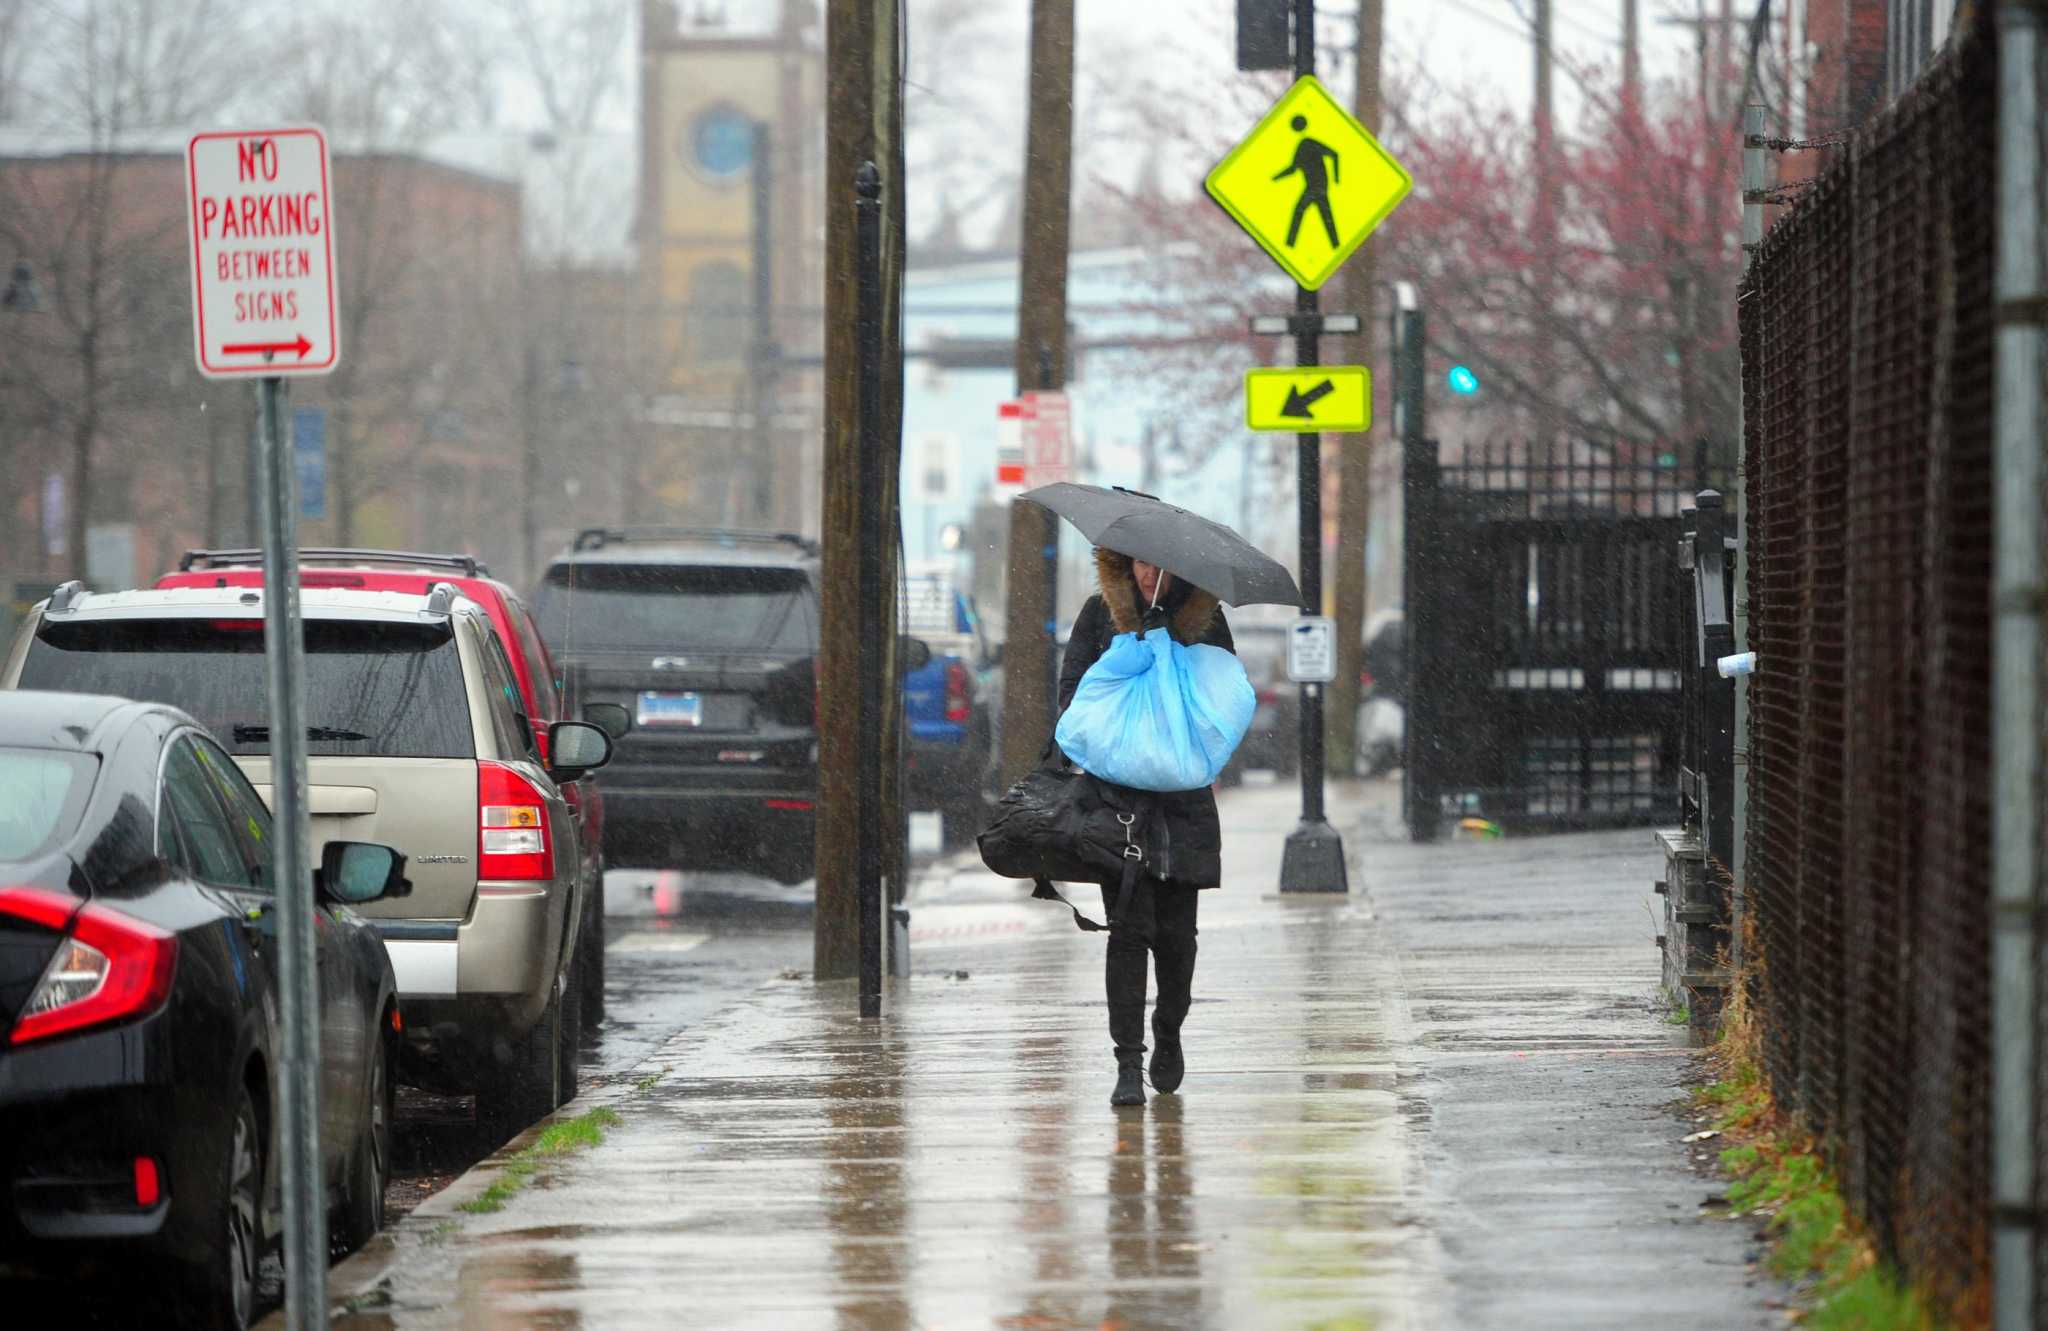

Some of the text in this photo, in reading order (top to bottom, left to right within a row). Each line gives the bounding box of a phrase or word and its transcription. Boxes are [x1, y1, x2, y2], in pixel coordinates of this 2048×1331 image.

[237, 138, 278, 182] NO
[202, 192, 320, 240] PARKING
[217, 250, 311, 281] BETWEEN
[234, 291, 299, 322] SIGNS
[416, 855, 468, 864] LIMITED
